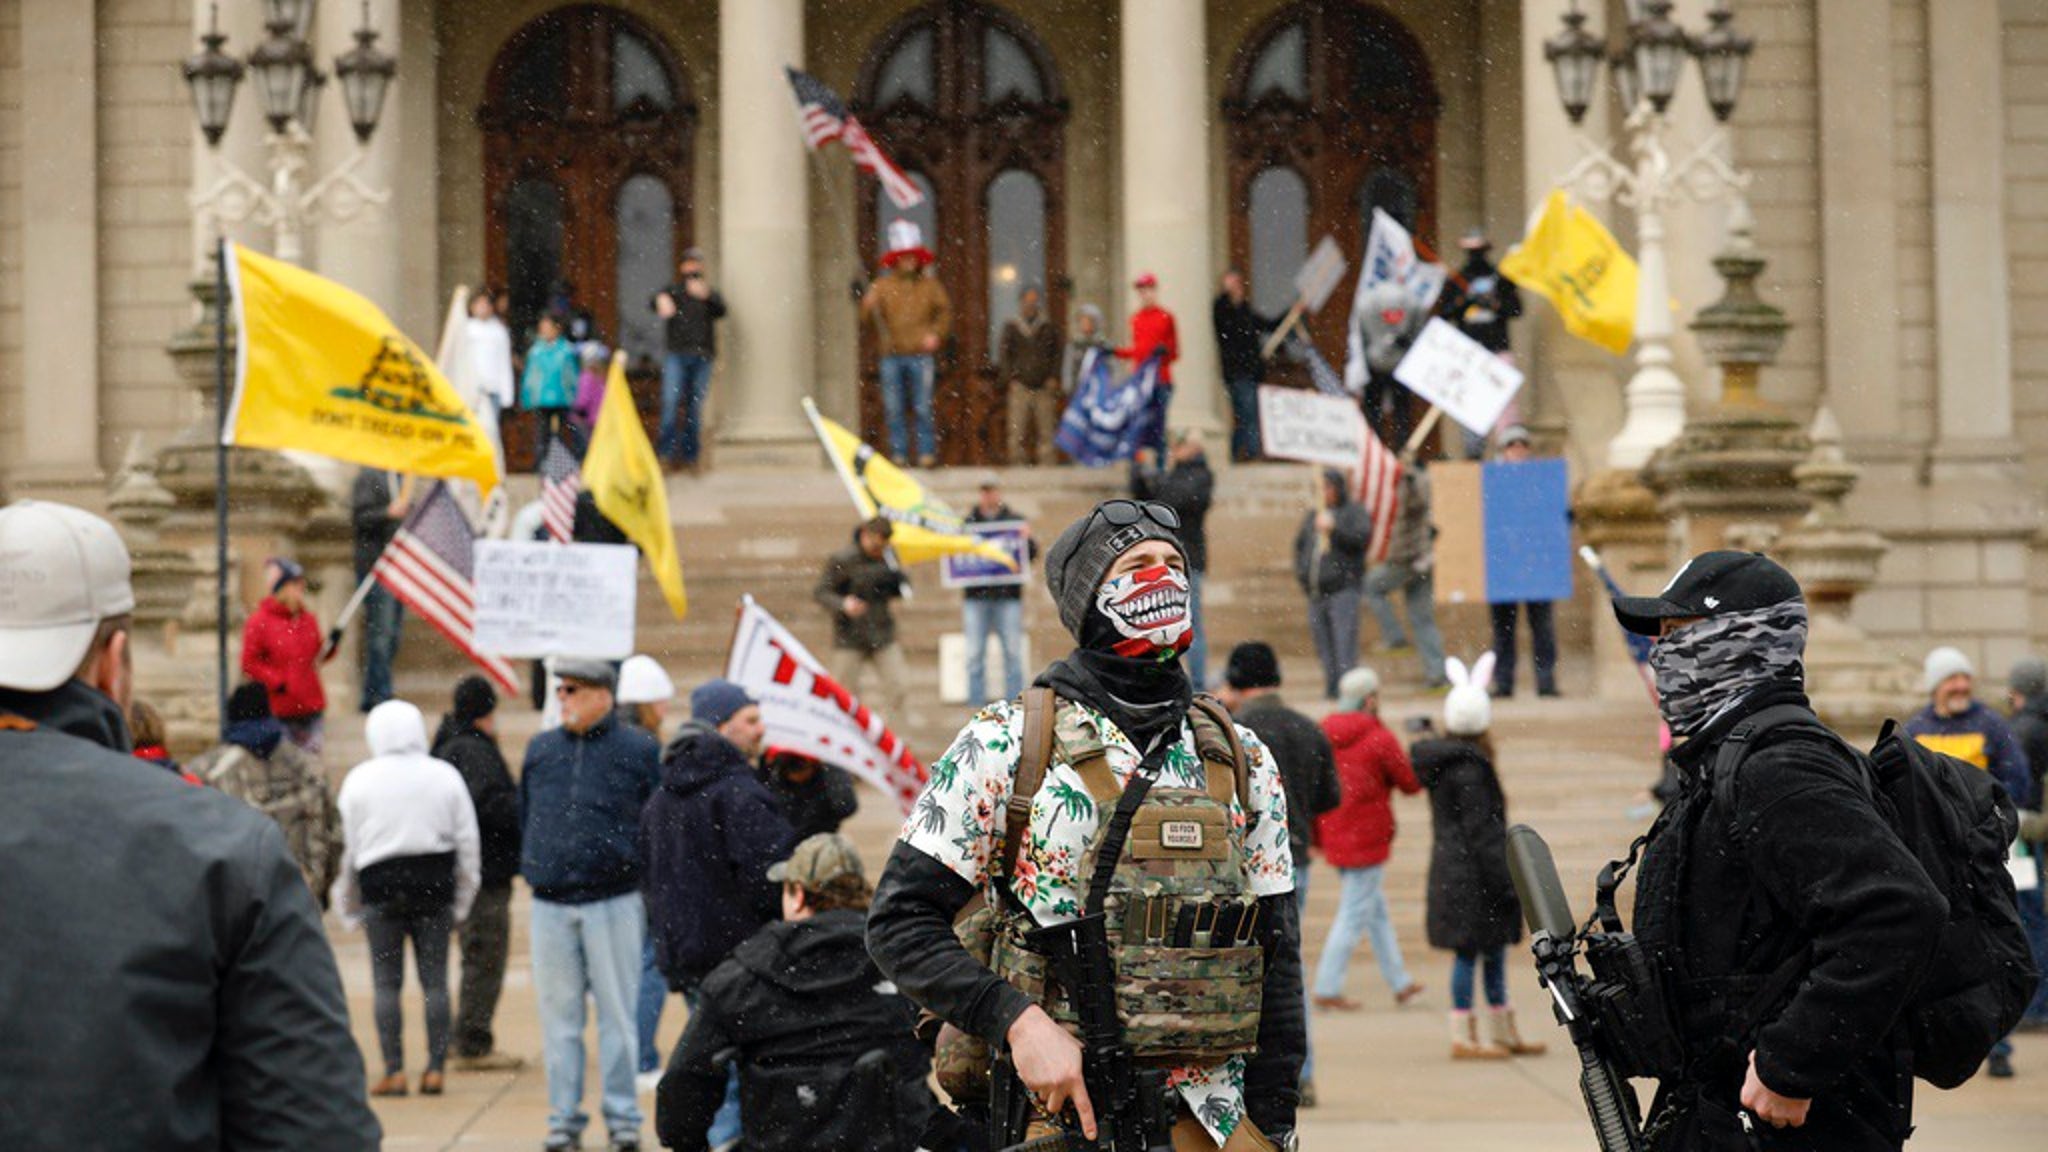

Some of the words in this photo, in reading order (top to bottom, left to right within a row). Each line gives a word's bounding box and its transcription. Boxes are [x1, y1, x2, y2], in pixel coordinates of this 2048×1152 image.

[361, 416, 415, 439] TREAD
[420, 427, 445, 442] ON
[1168, 836, 1197, 844] YOURSELF
